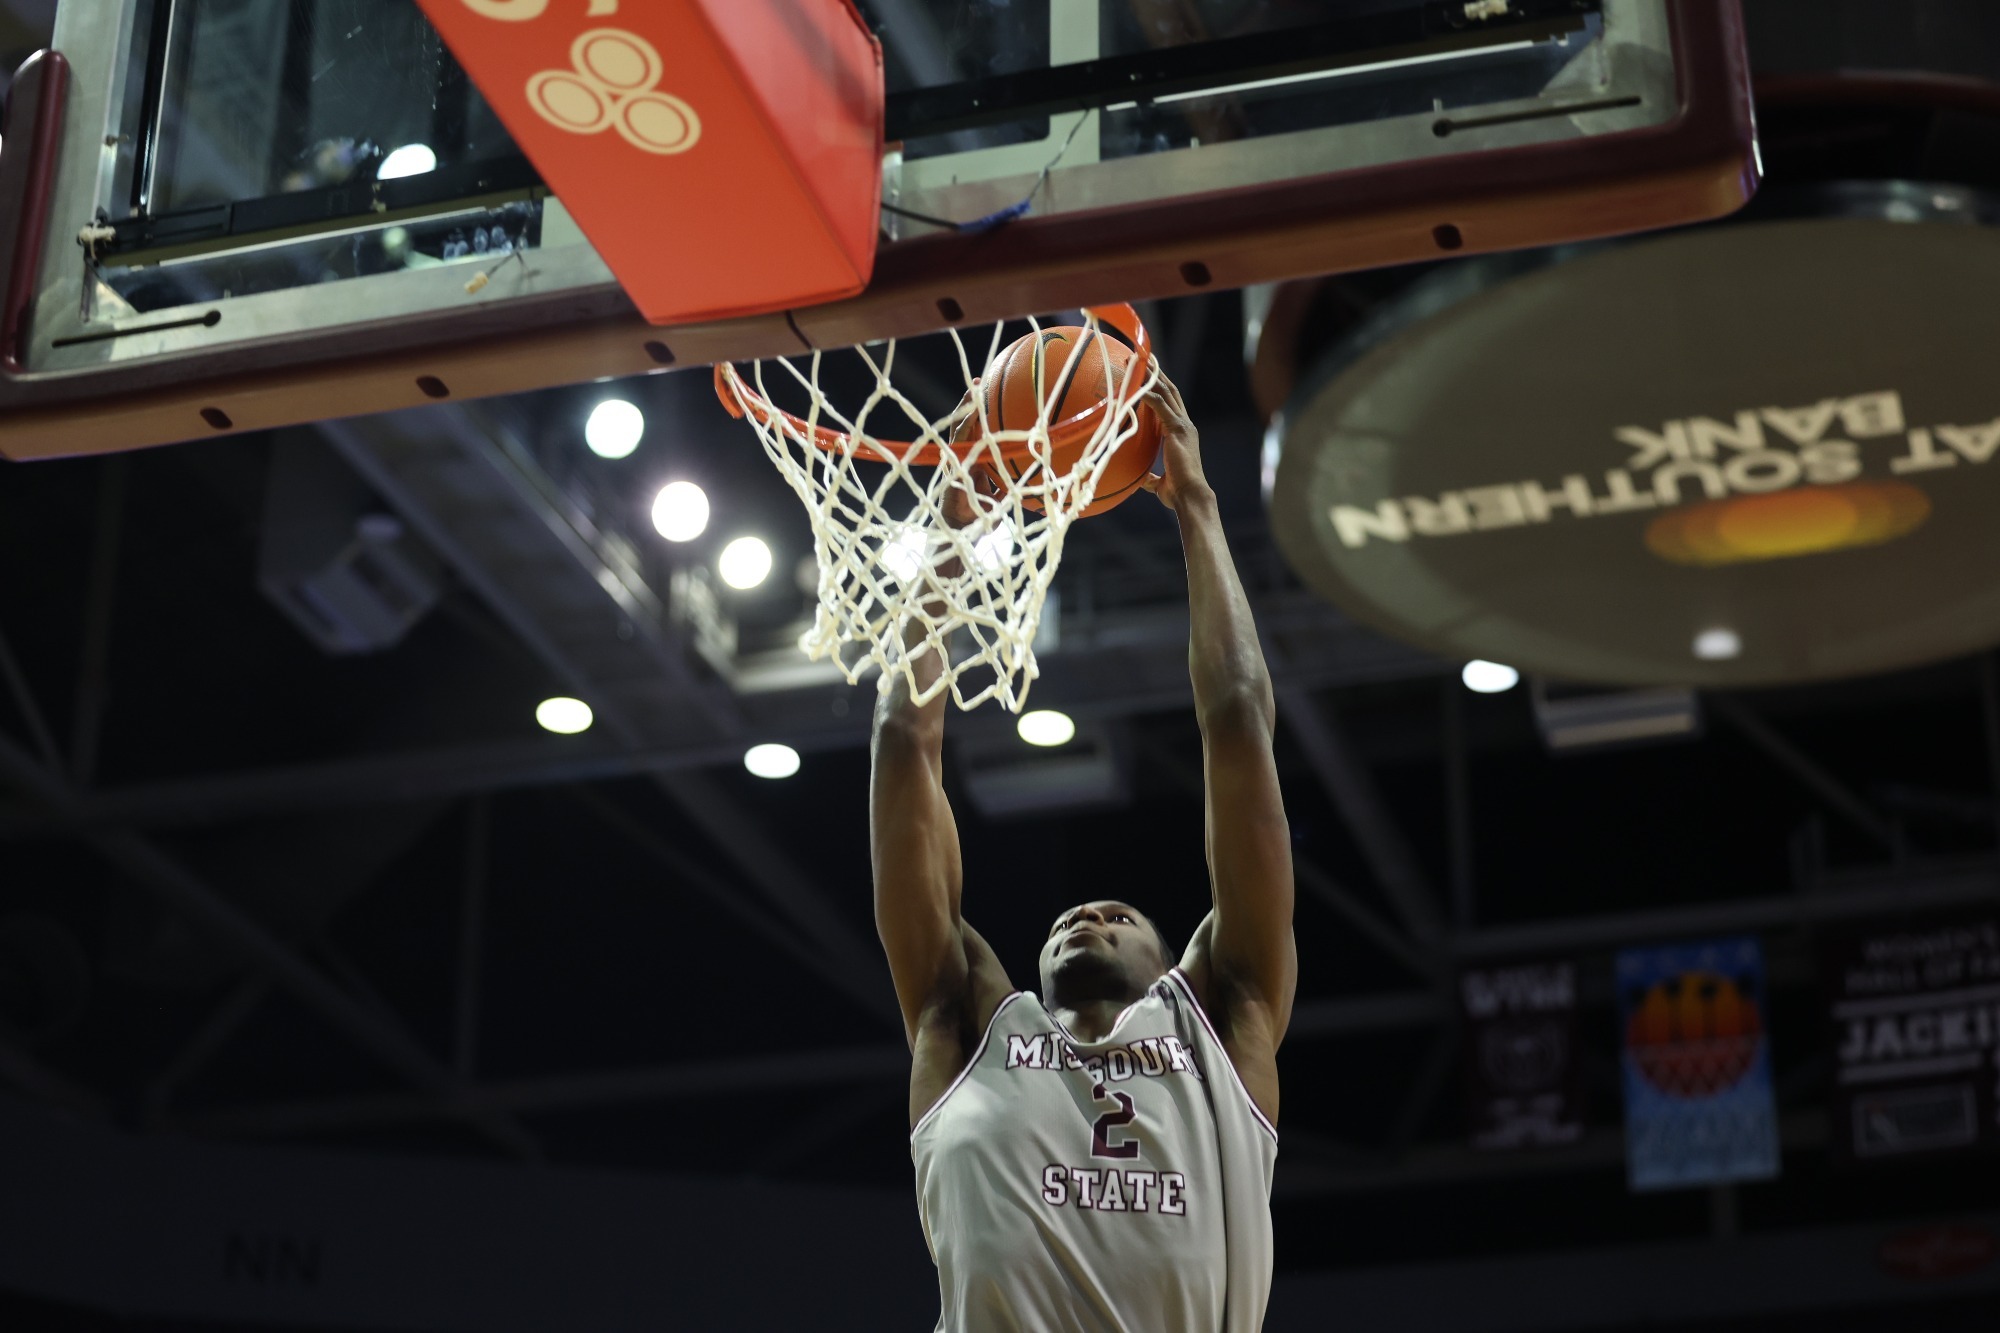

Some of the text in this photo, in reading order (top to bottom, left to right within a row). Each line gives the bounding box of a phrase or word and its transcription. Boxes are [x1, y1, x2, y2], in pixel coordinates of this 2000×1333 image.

[1614, 390, 1903, 471] BANK
[1331, 440, 1862, 548] SOUTHERN
[1090, 1084, 1140, 1160] 2
[1042, 1164, 1186, 1216] STATE
